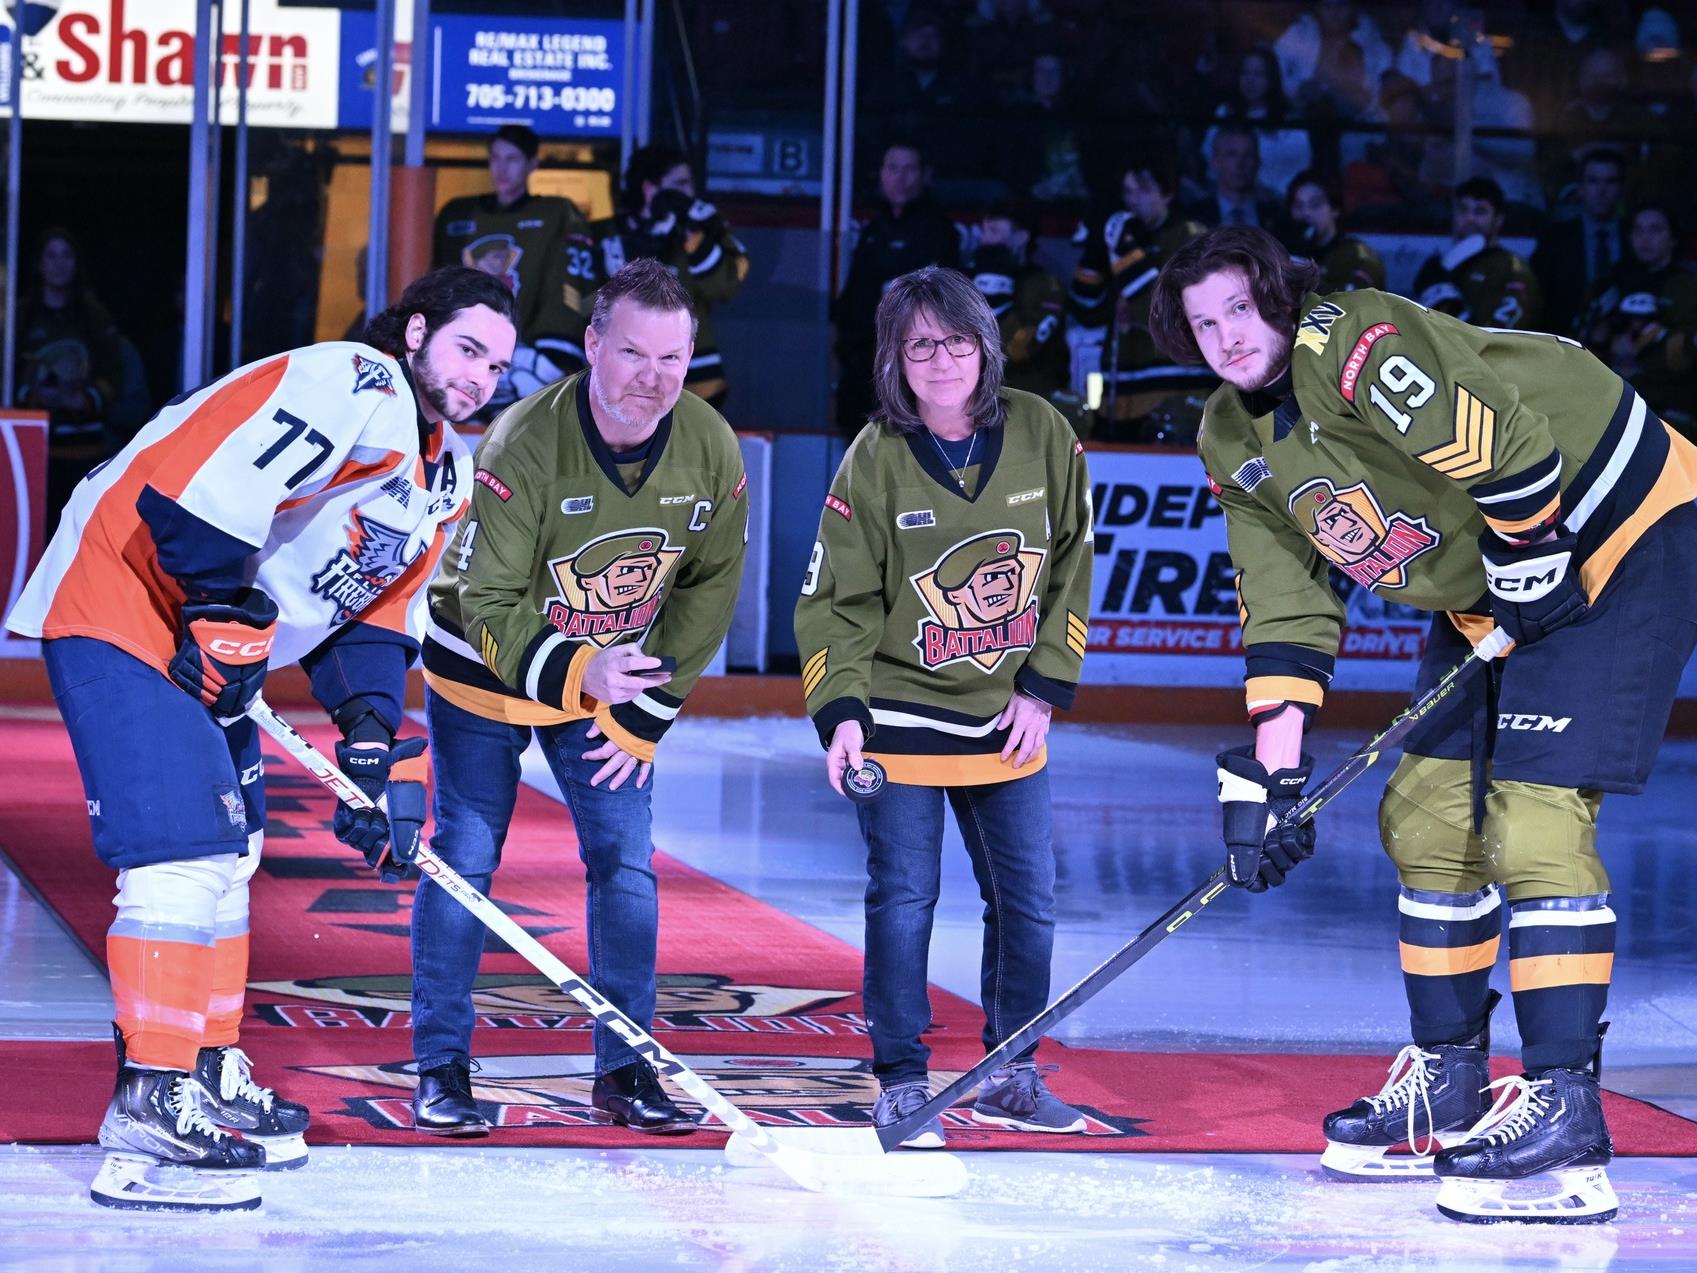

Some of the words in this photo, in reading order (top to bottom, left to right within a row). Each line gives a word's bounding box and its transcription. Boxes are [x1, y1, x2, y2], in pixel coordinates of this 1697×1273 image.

[469, 48, 510, 67] REAL
[513, 50, 575, 69] ESTATE
[543, 34, 607, 52] LEGEND
[465, 83, 615, 112] 705-713-0300
[566, 247, 595, 280] 32
[1342, 345, 1368, 391] NORTH
[1366, 322, 1391, 343] BAY
[1369, 355, 1437, 437] 19
[252, 407, 335, 491] 77
[440, 450, 457, 495] A
[488, 478, 507, 495] BAY
[659, 494, 695, 505] CCM
[832, 499, 850, 516] BAY
[1007, 488, 1045, 505] CCM
[688, 499, 712, 532] C
[457, 519, 480, 572] 4
[549, 592, 662, 638] BATTALION
[924, 602, 1038, 667] BATTALION
[1115, 627, 1222, 649] SERVICE
[1419, 681, 1456, 716] BAUER
[350, 756, 380, 765] CCM
[1279, 776, 1307, 786] CCM
[560, 978, 686, 1076] CCM
